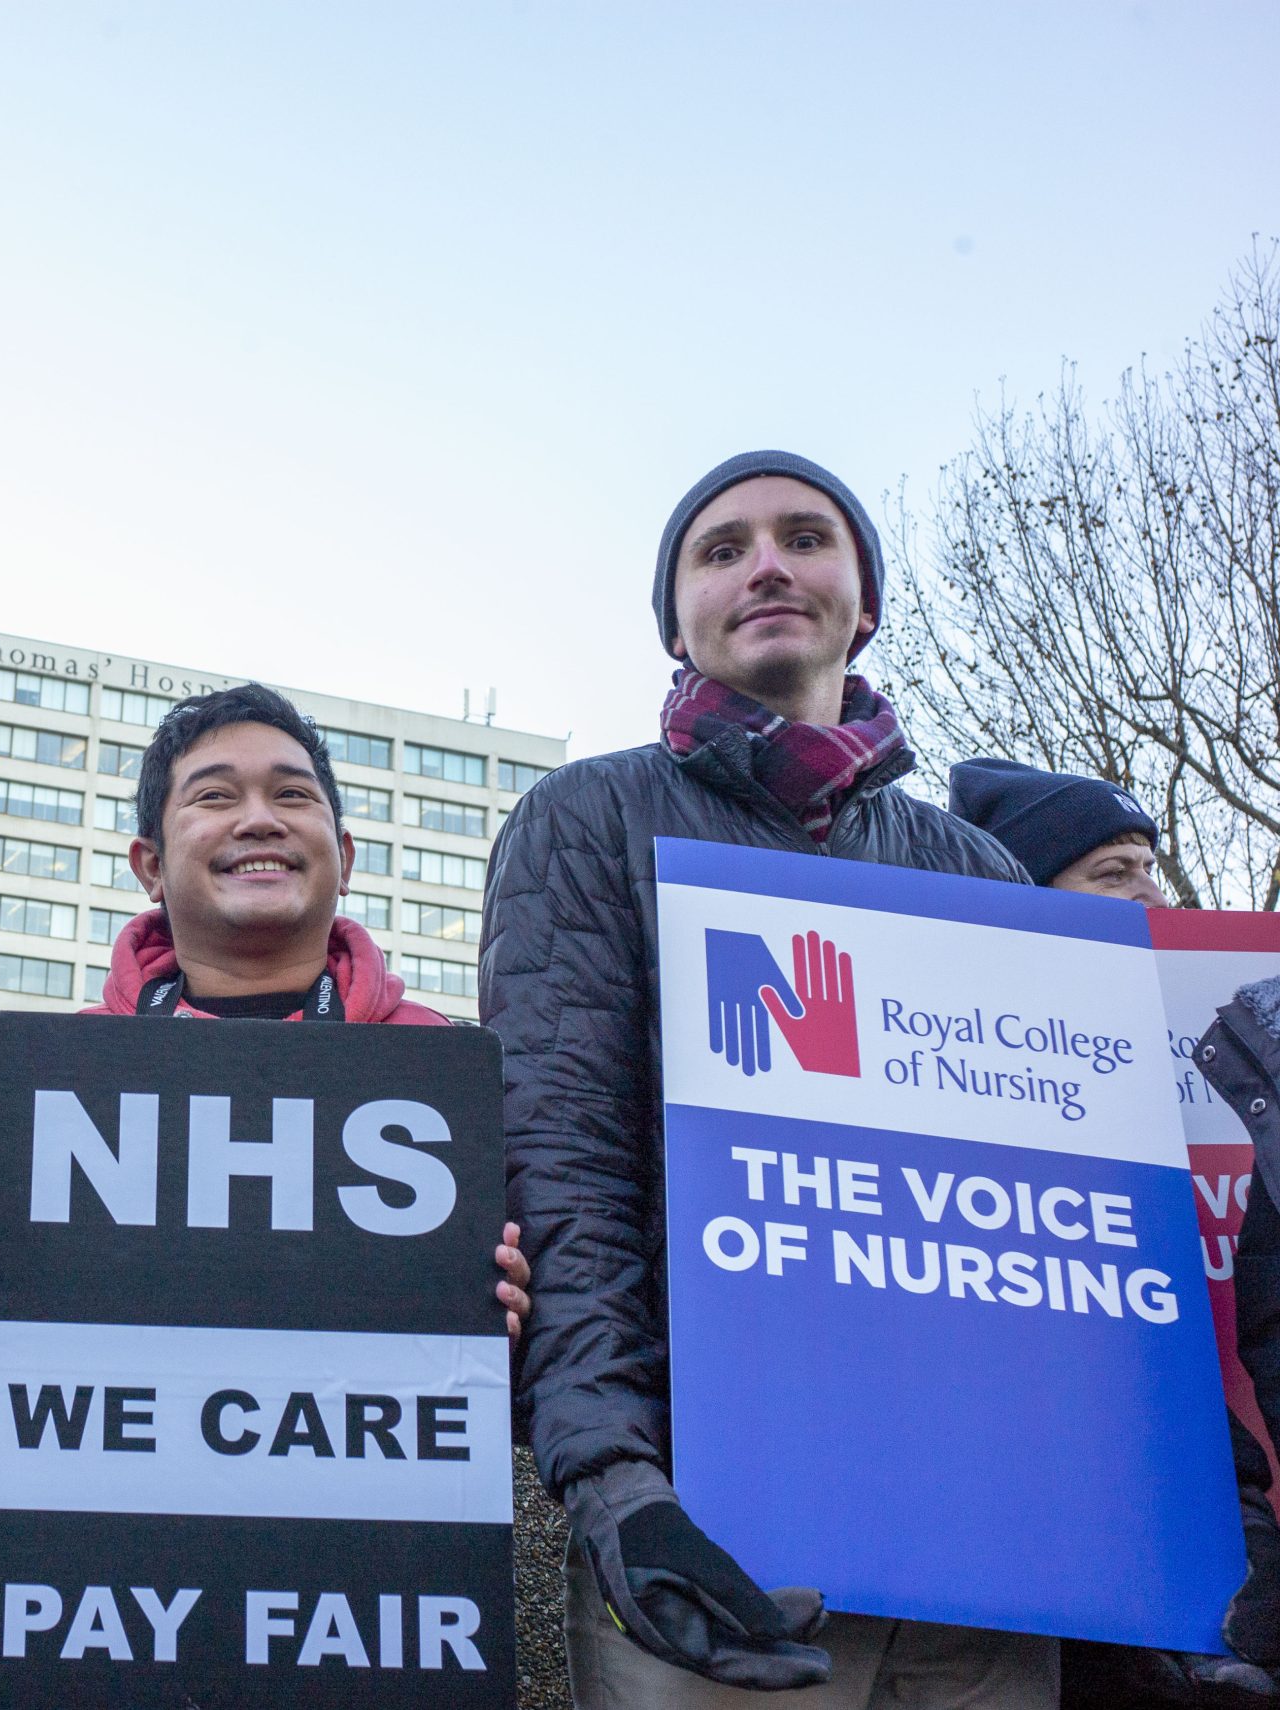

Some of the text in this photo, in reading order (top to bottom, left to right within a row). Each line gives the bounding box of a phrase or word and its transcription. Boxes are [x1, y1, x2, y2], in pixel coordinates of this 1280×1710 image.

[880, 998, 985, 1051] Royal
[994, 1013, 1134, 1074] College
[884, 1051, 1087, 1122] of Nursing
[29, 1089, 457, 1237] NHS
[731, 1145, 884, 1216] THE
[901, 1166, 1138, 1249] VOICE
[702, 1215, 808, 1277] OF
[832, 1229, 1180, 1325] NURSING
[7, 1383, 471, 1462] WE CARE
[2, 1583, 488, 1672] PAY FAIR
